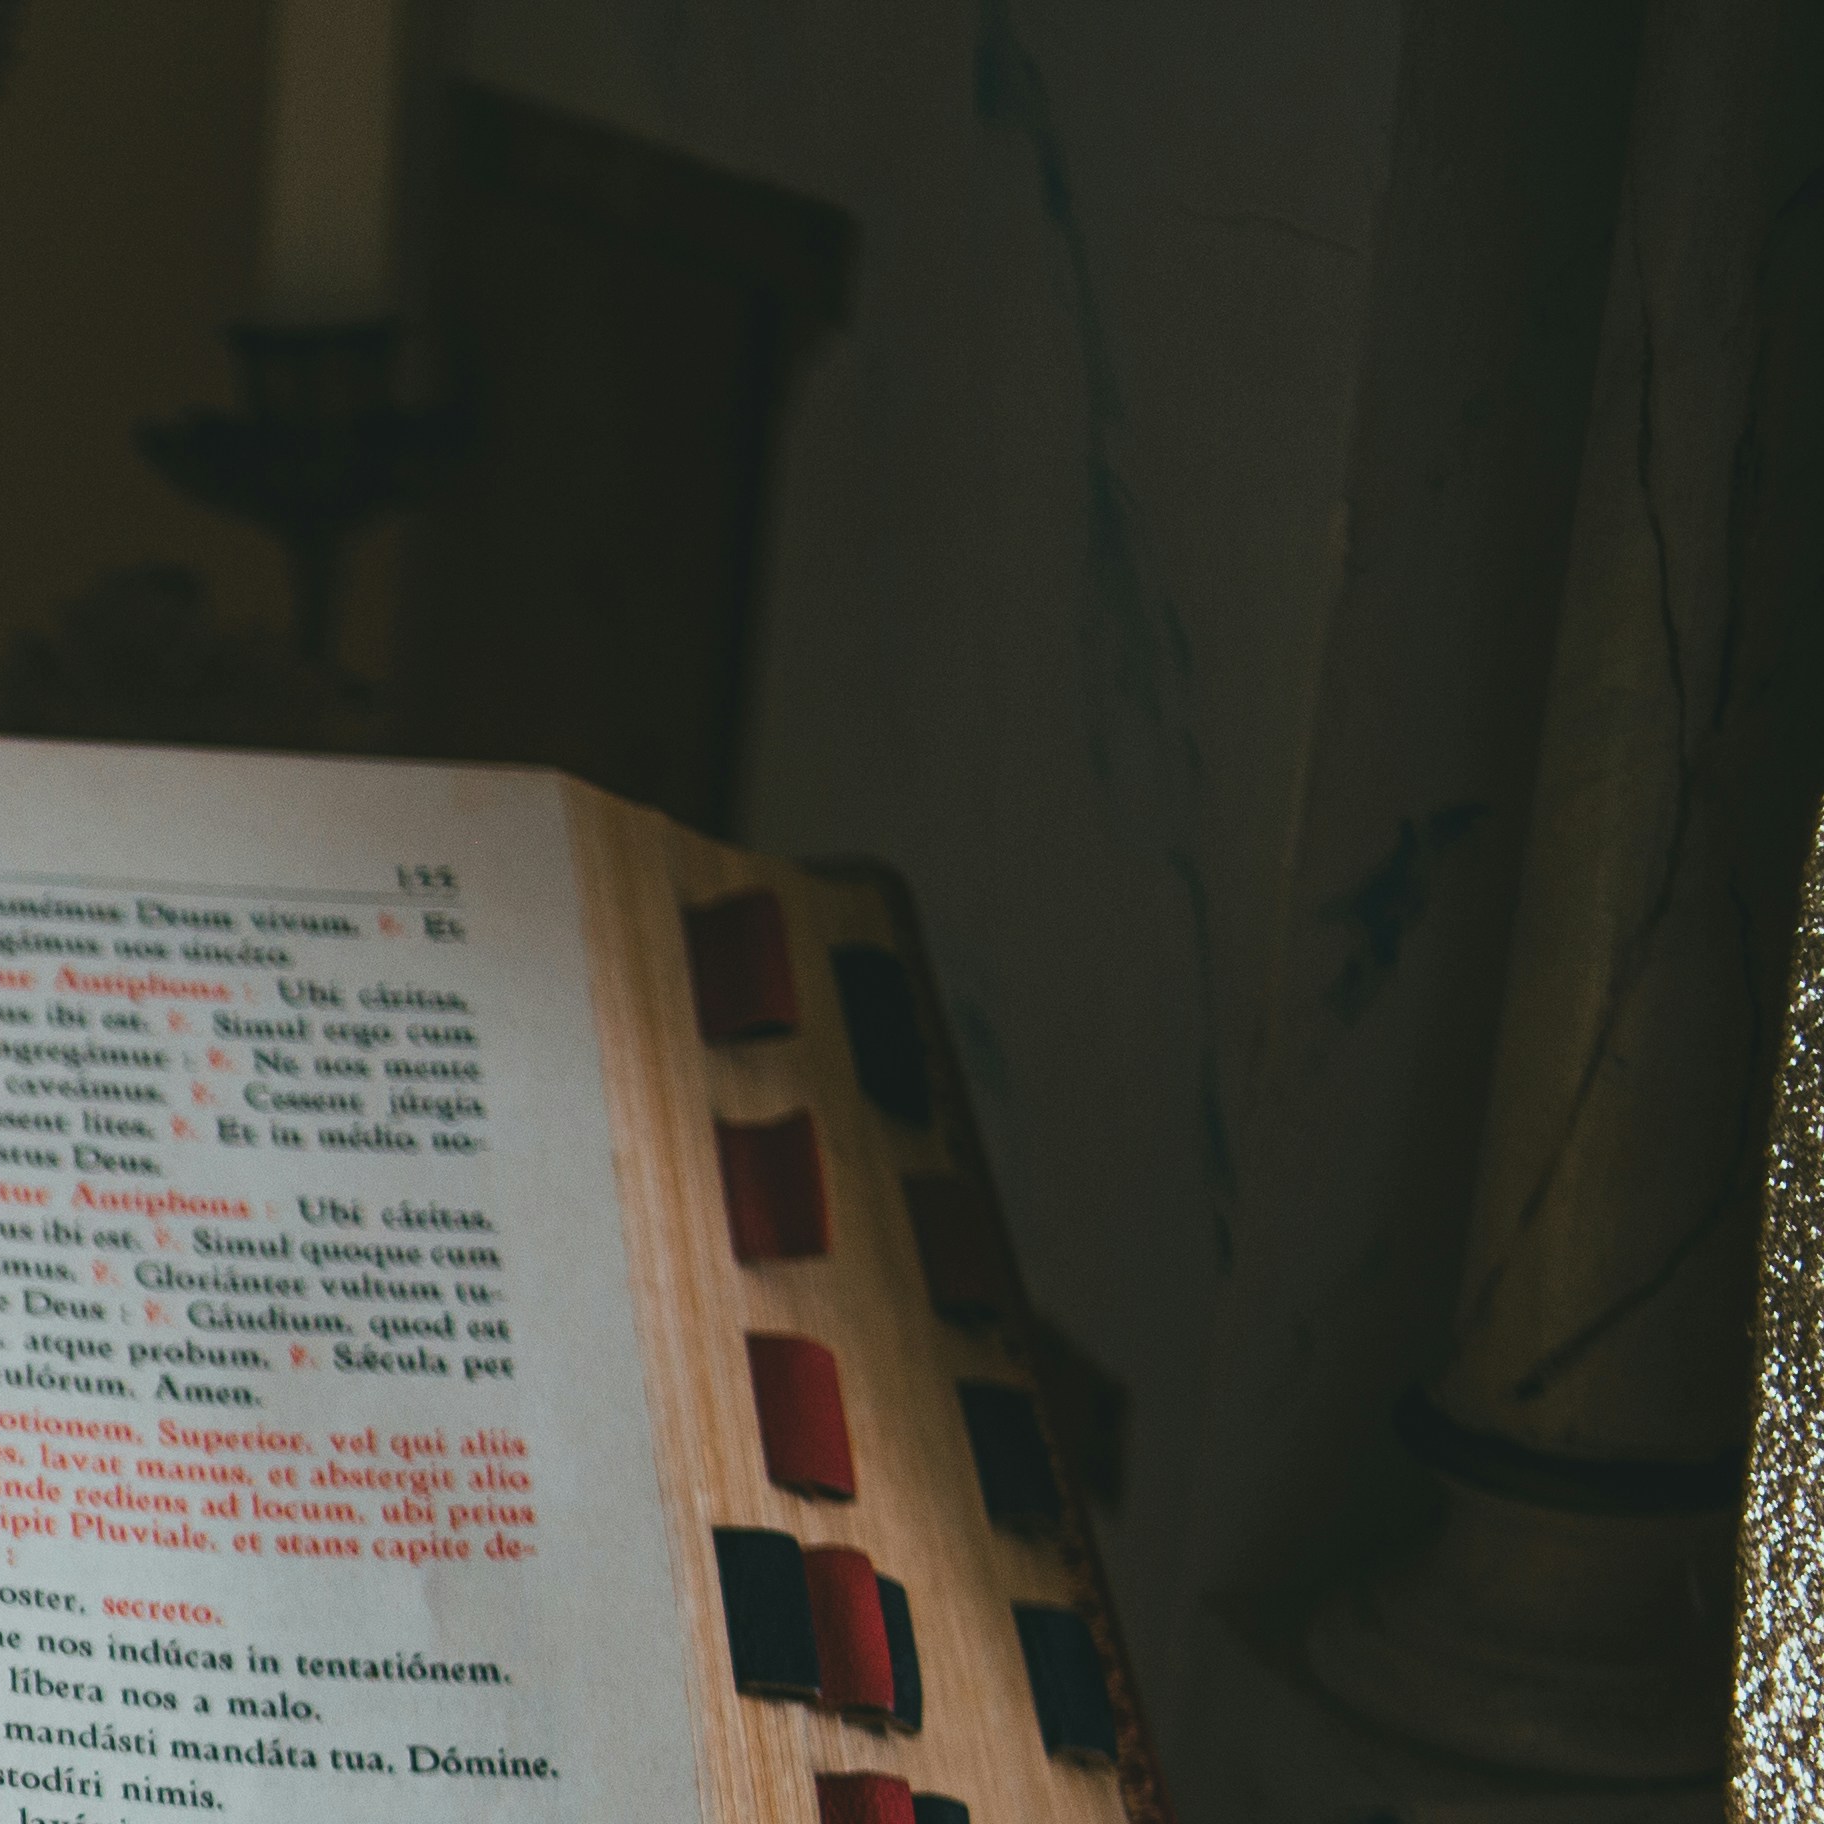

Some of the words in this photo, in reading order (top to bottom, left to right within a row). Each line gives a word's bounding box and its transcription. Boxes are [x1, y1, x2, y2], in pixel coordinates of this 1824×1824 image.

[102, 1597, 223, 1625] secreto.
[37, 1635, 94, 1658] nos
[108, 1638, 235, 1671] indúcas
[248, 1645, 281, 1675] in
[296, 1652, 511, 1685] tentatiónem.
[122, 1780, 223, 1810] nimis.
